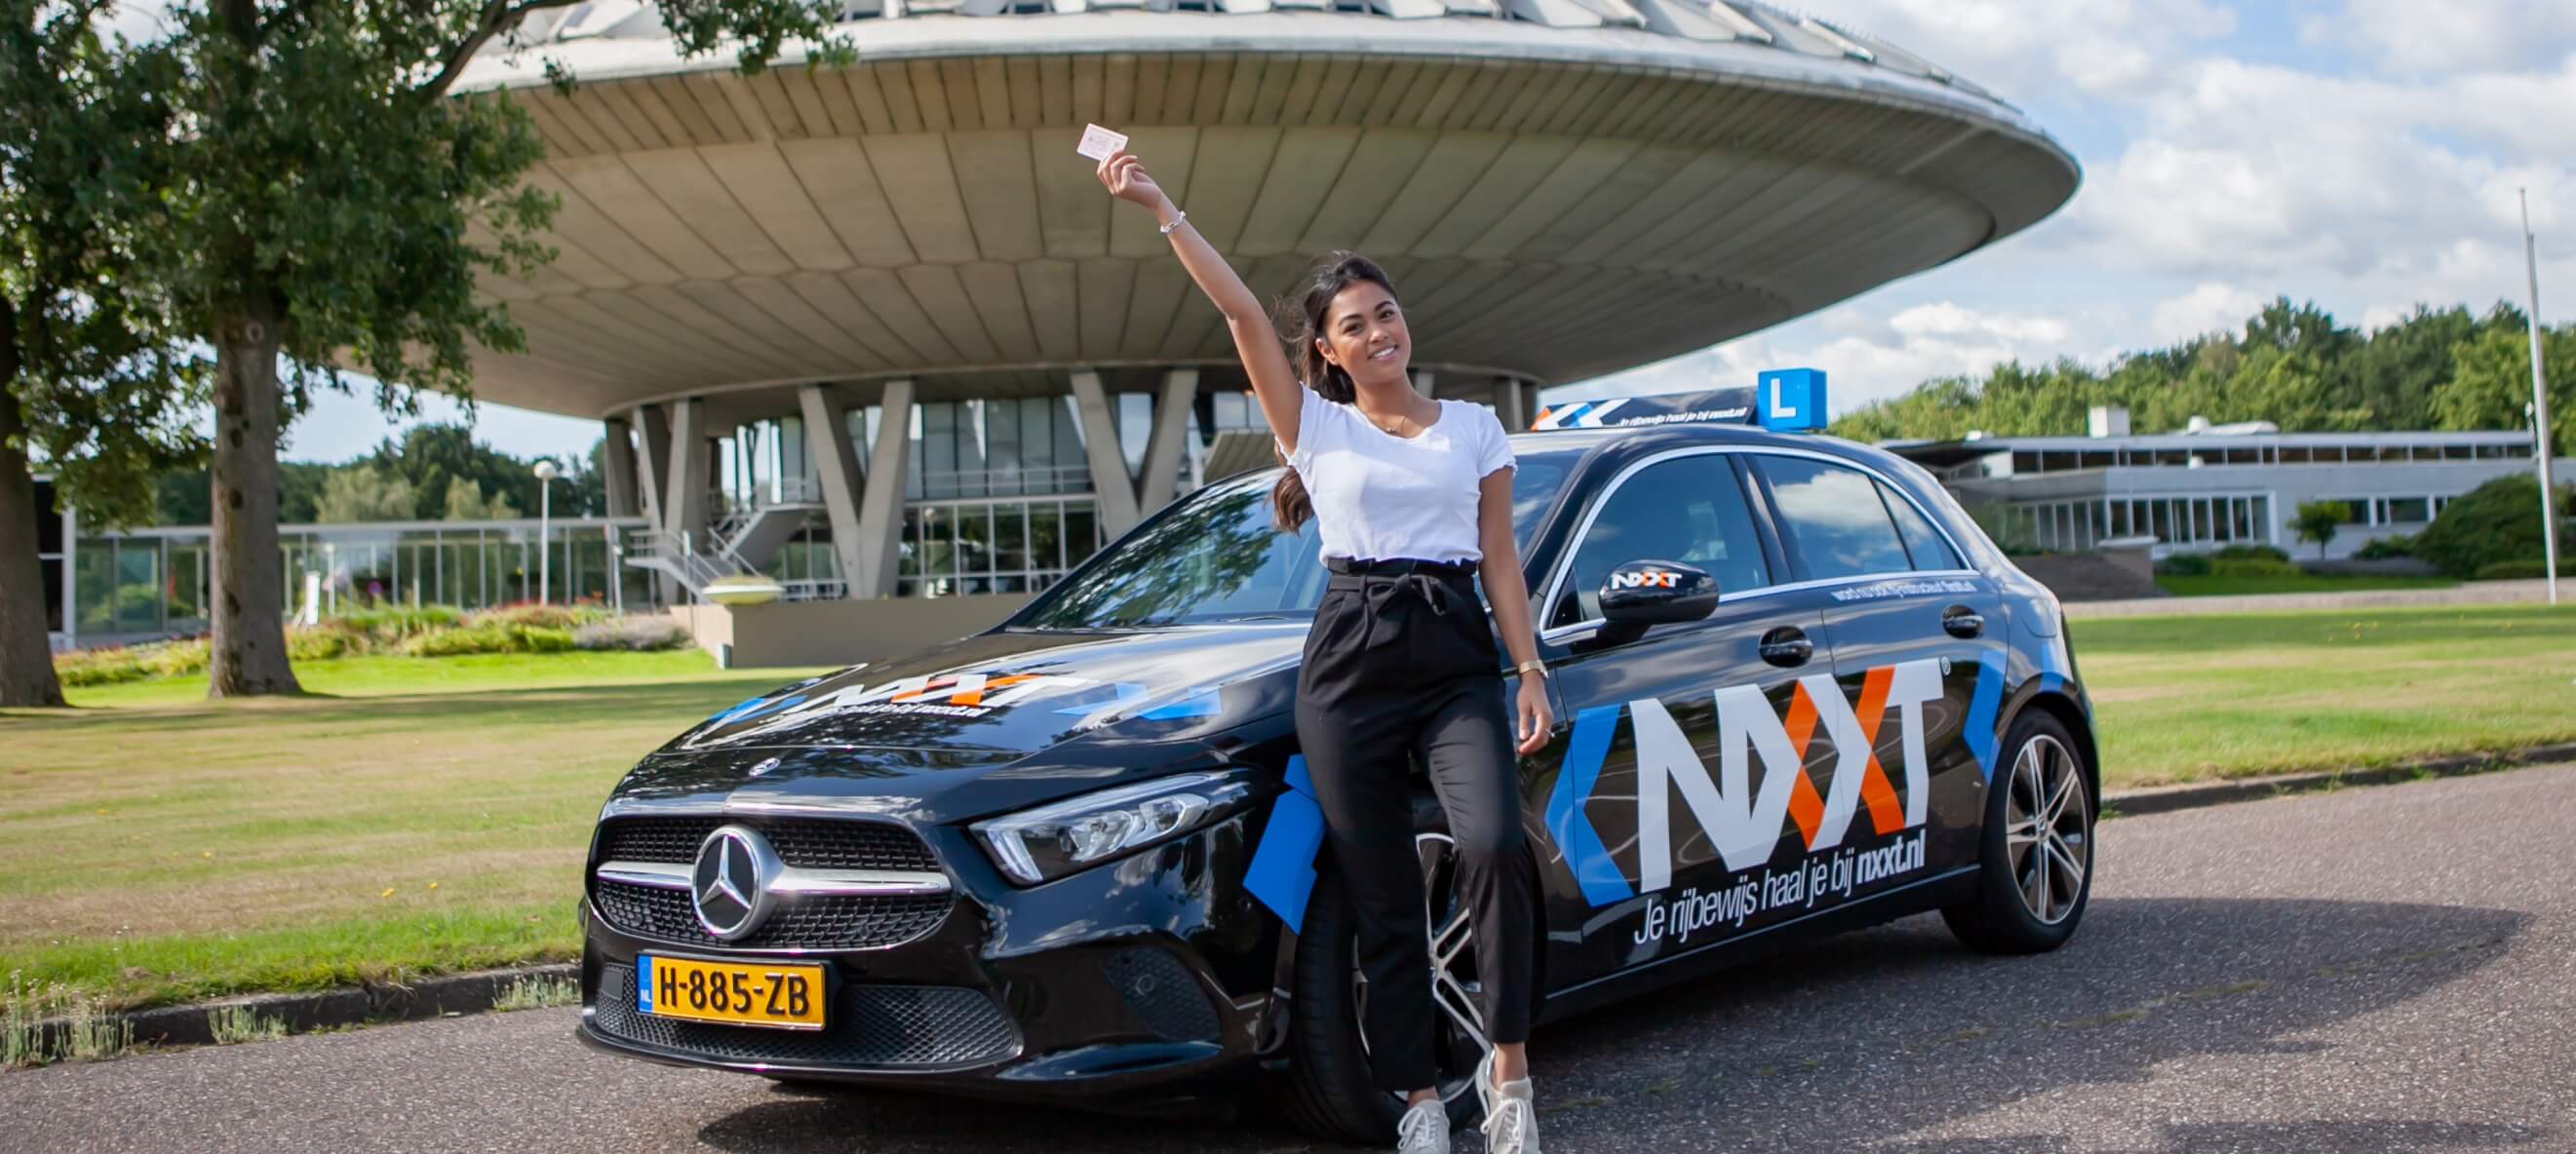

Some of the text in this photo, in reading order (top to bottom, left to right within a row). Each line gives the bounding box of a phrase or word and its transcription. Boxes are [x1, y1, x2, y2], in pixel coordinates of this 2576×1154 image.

[1771, 378, 1797, 419] L
[1610, 571, 1683, 590] NXXT
[1634, 828, 1927, 945] Je rijbewijs haal je bij nxxt.nl
[659, 966, 810, 1018] H-885-ZB
